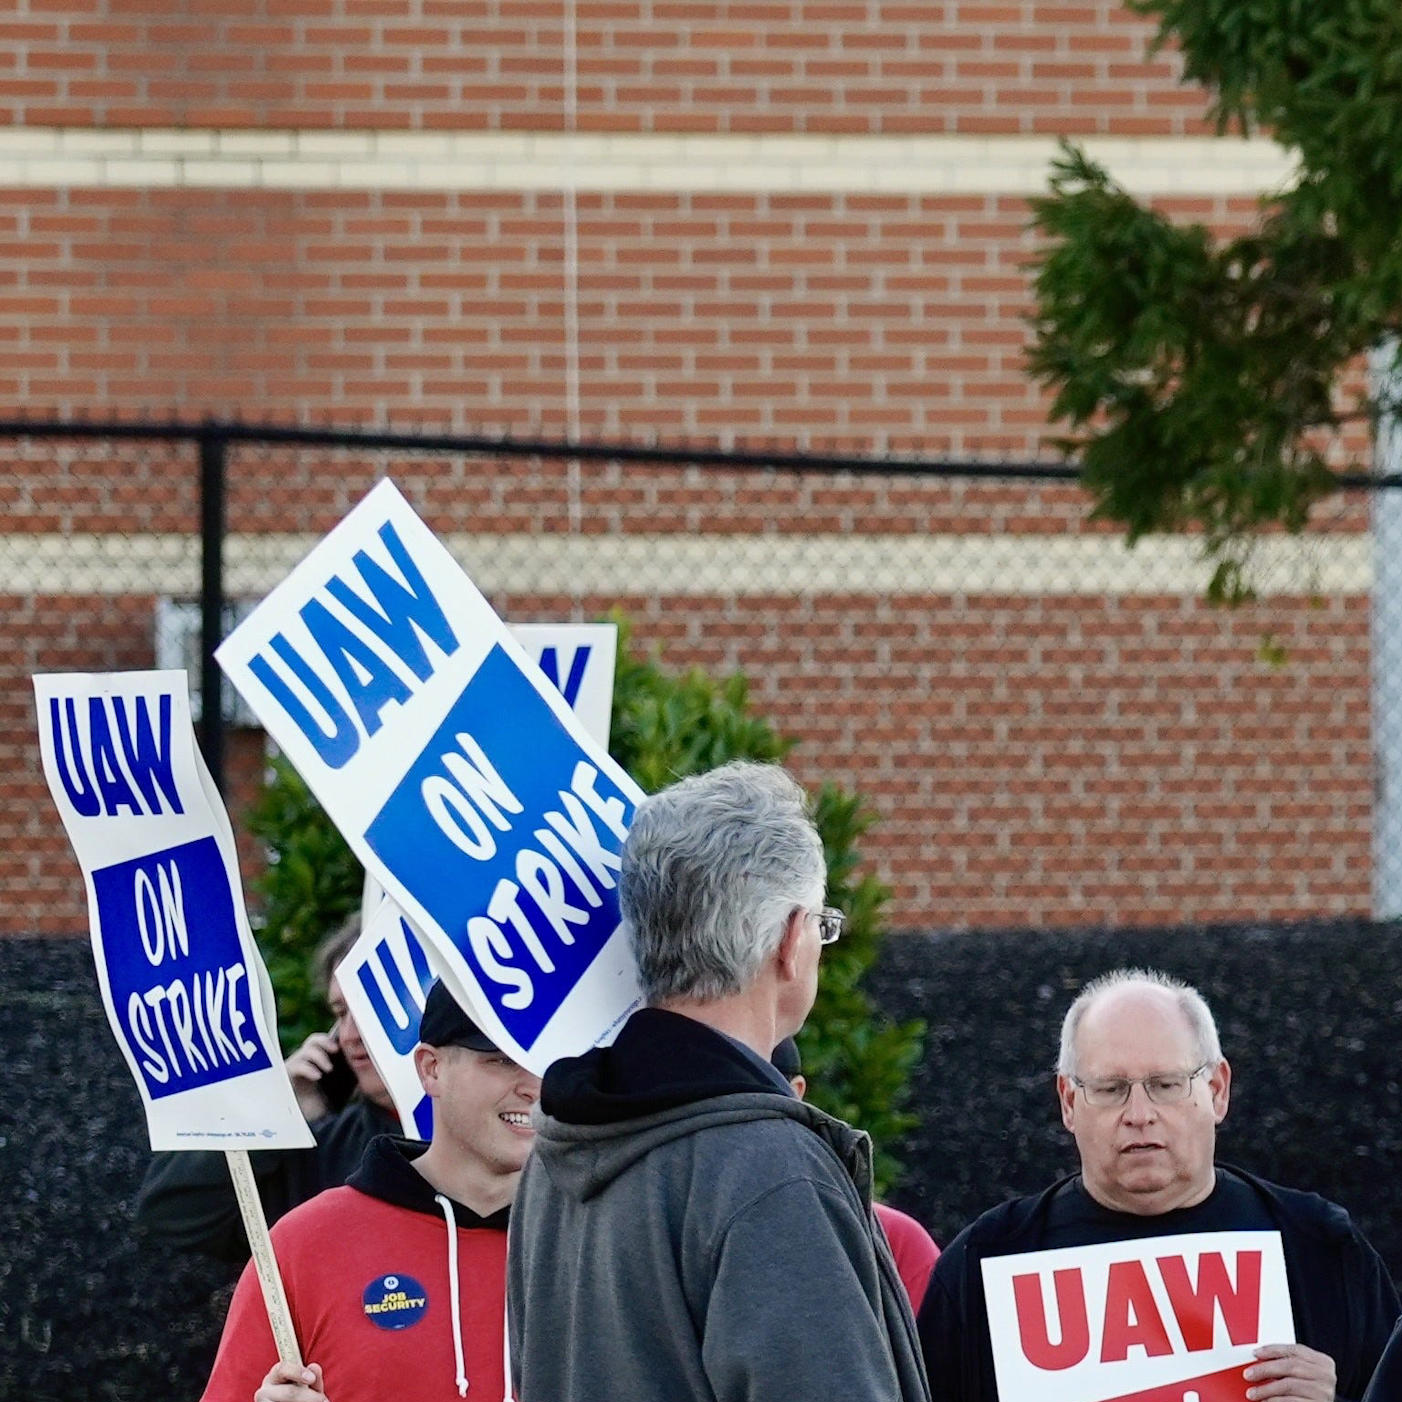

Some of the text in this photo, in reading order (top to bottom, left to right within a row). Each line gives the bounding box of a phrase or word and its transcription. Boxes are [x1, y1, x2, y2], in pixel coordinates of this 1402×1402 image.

[247, 519, 460, 770] UAW
[49, 694, 185, 817] UAW
[421, 732, 524, 861] ON
[135, 860, 189, 966] ON
[129, 963, 258, 1084] STRIKE
[364, 1298, 425, 1314] SECURITY
[382, 1292, 406, 1303] JOB
[1012, 1250, 1262, 1371] UAW
